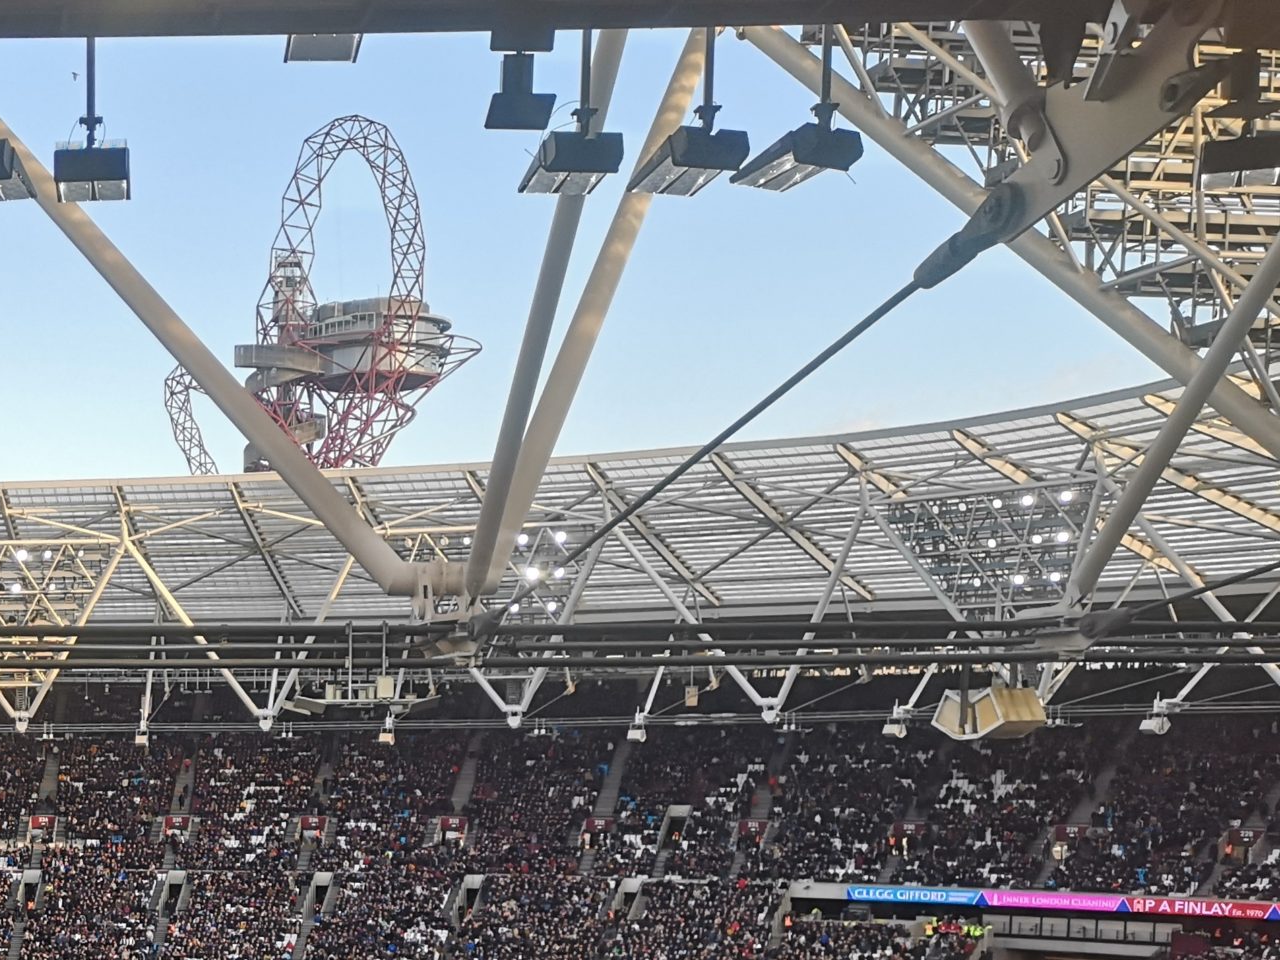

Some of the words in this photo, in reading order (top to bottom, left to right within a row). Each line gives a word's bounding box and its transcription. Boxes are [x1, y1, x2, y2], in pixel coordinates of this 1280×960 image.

[854, 888, 894, 899] CLEGG
[896, 890, 946, 902] GIFFORD
[1032, 896, 1069, 906] LONDON
[1144, 900, 1155, 912] P
[1158, 900, 1171, 912] A
[1174, 901, 1233, 916] FINLAY
[1246, 909, 1264, 918] 1970
